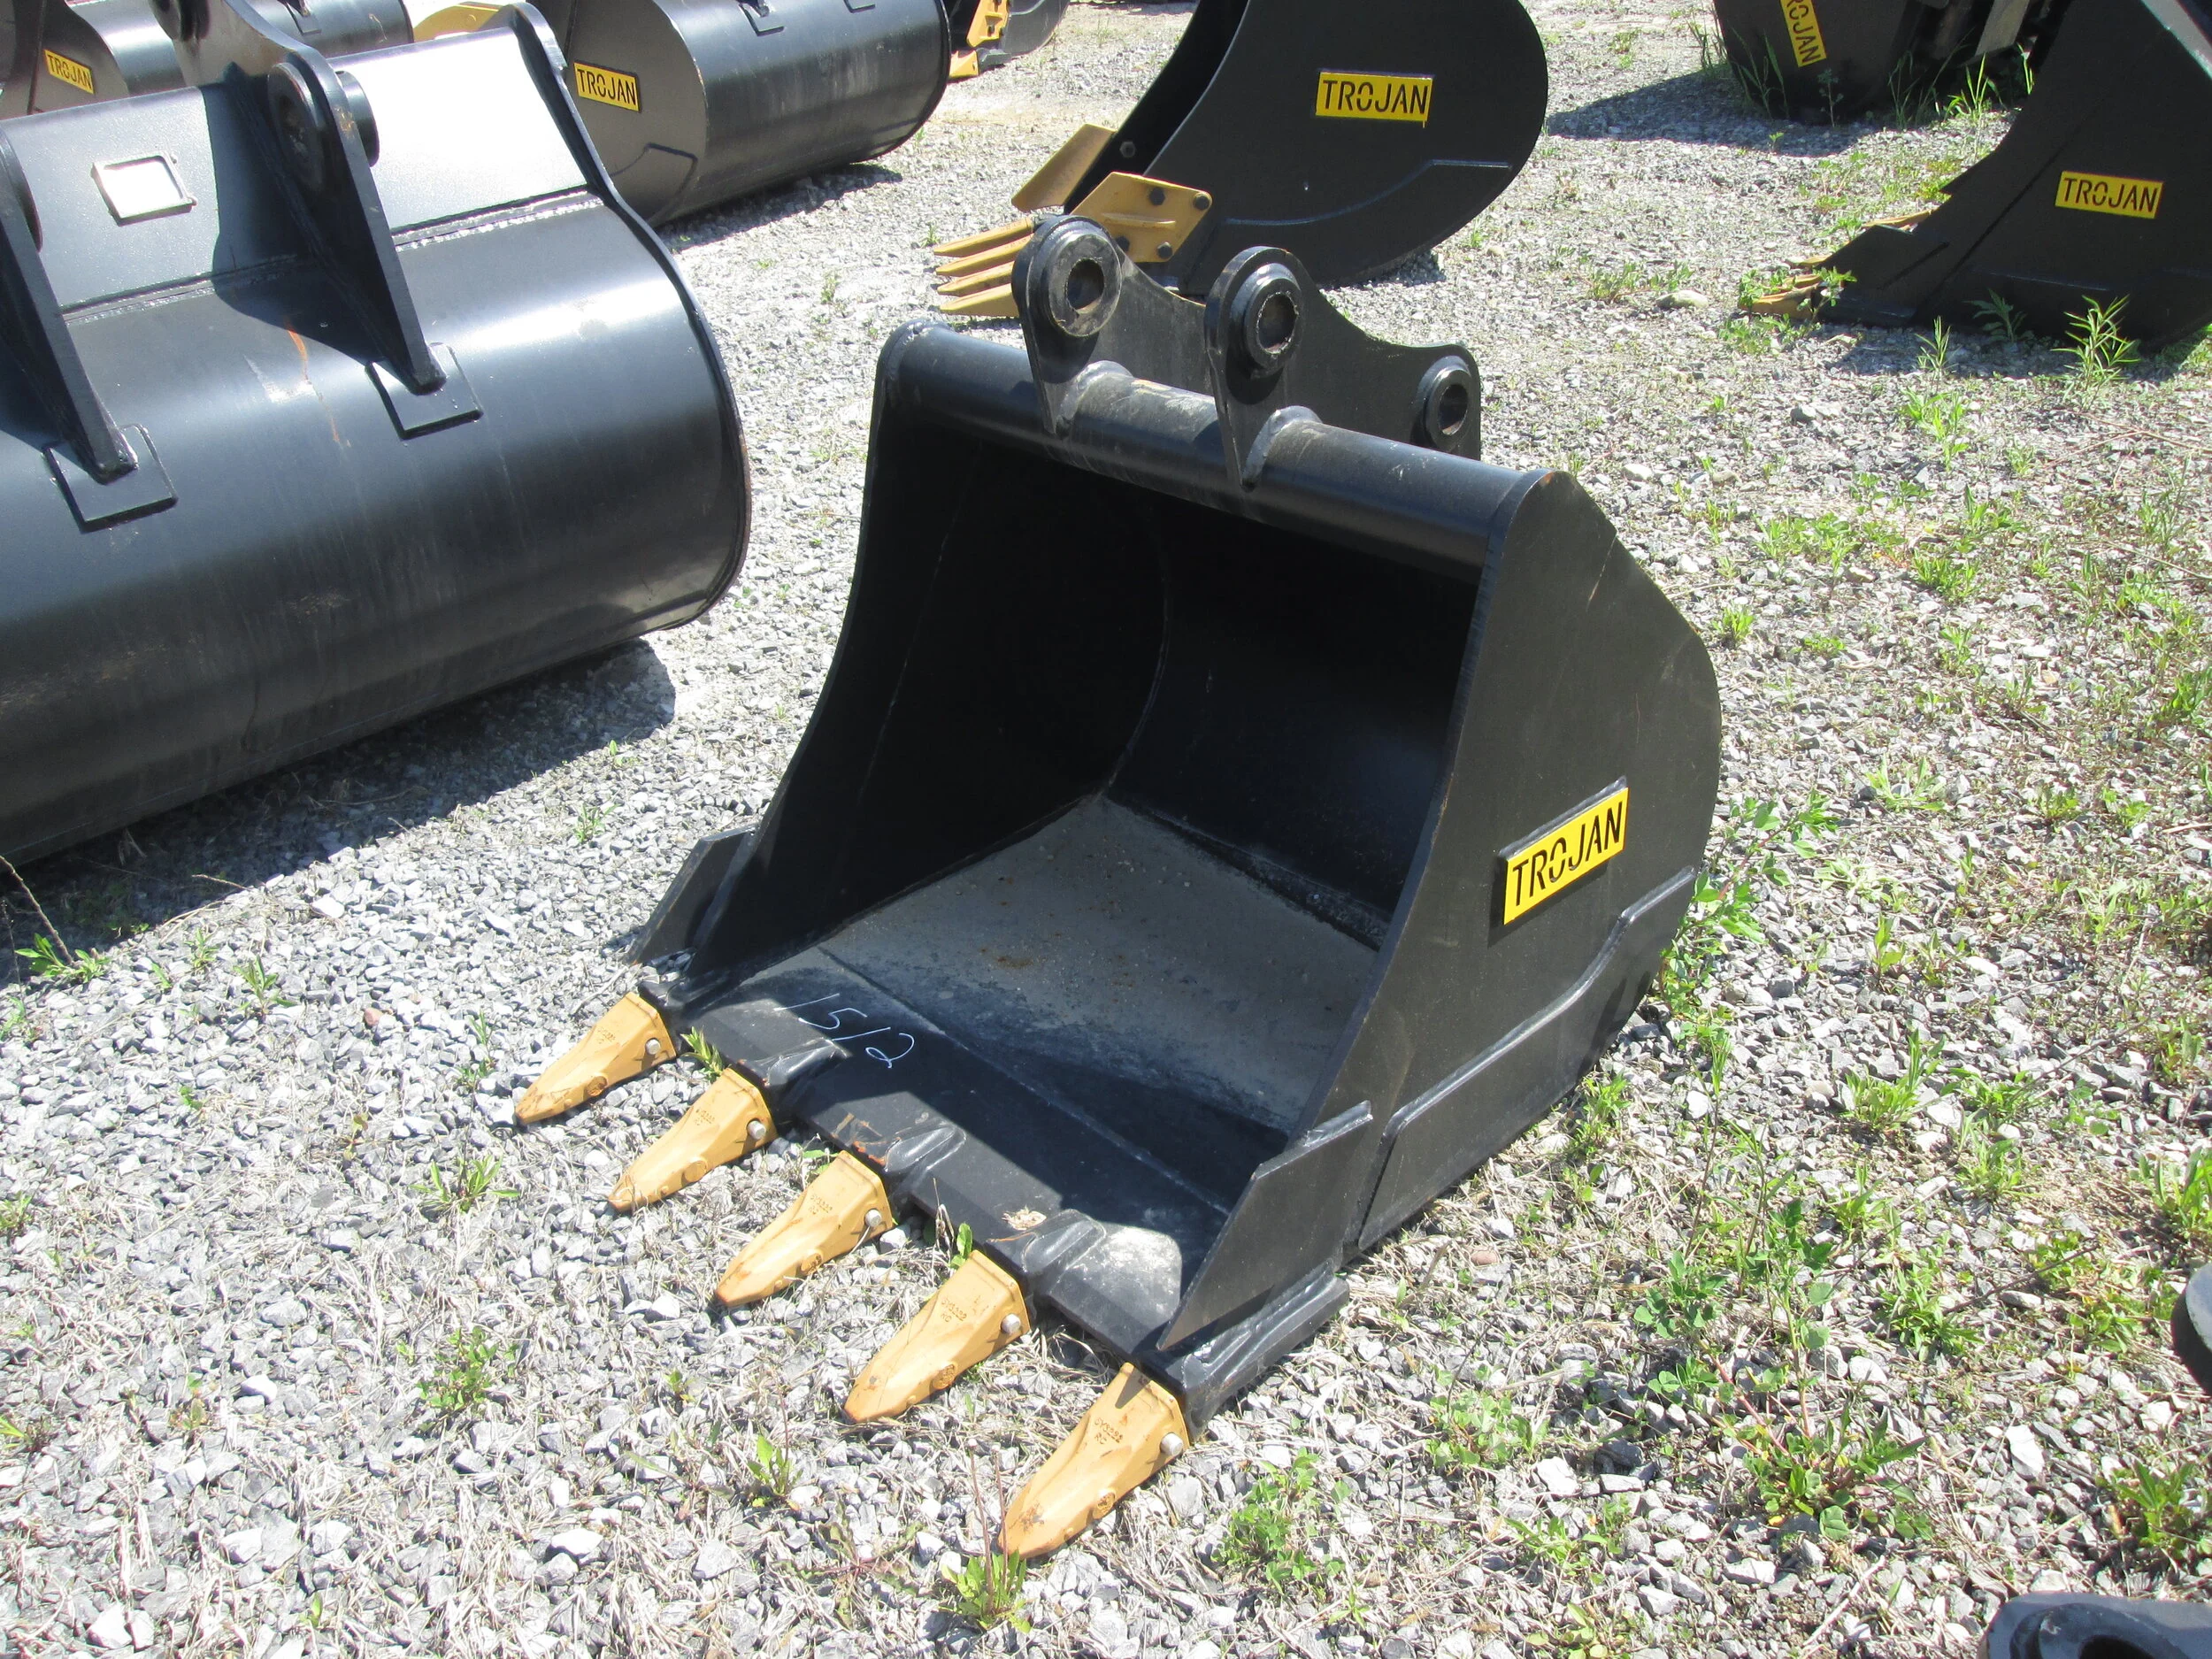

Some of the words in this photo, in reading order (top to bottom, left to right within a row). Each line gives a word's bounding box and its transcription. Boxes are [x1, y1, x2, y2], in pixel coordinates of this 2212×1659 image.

[47, 54, 92, 89] TROJAN
[577, 68, 636, 105] TROJAN
[1323, 80, 1428, 114] TROJAN
[2063, 177, 2159, 212] TROJAN
[1512, 801, 1623, 906] TROJAN
